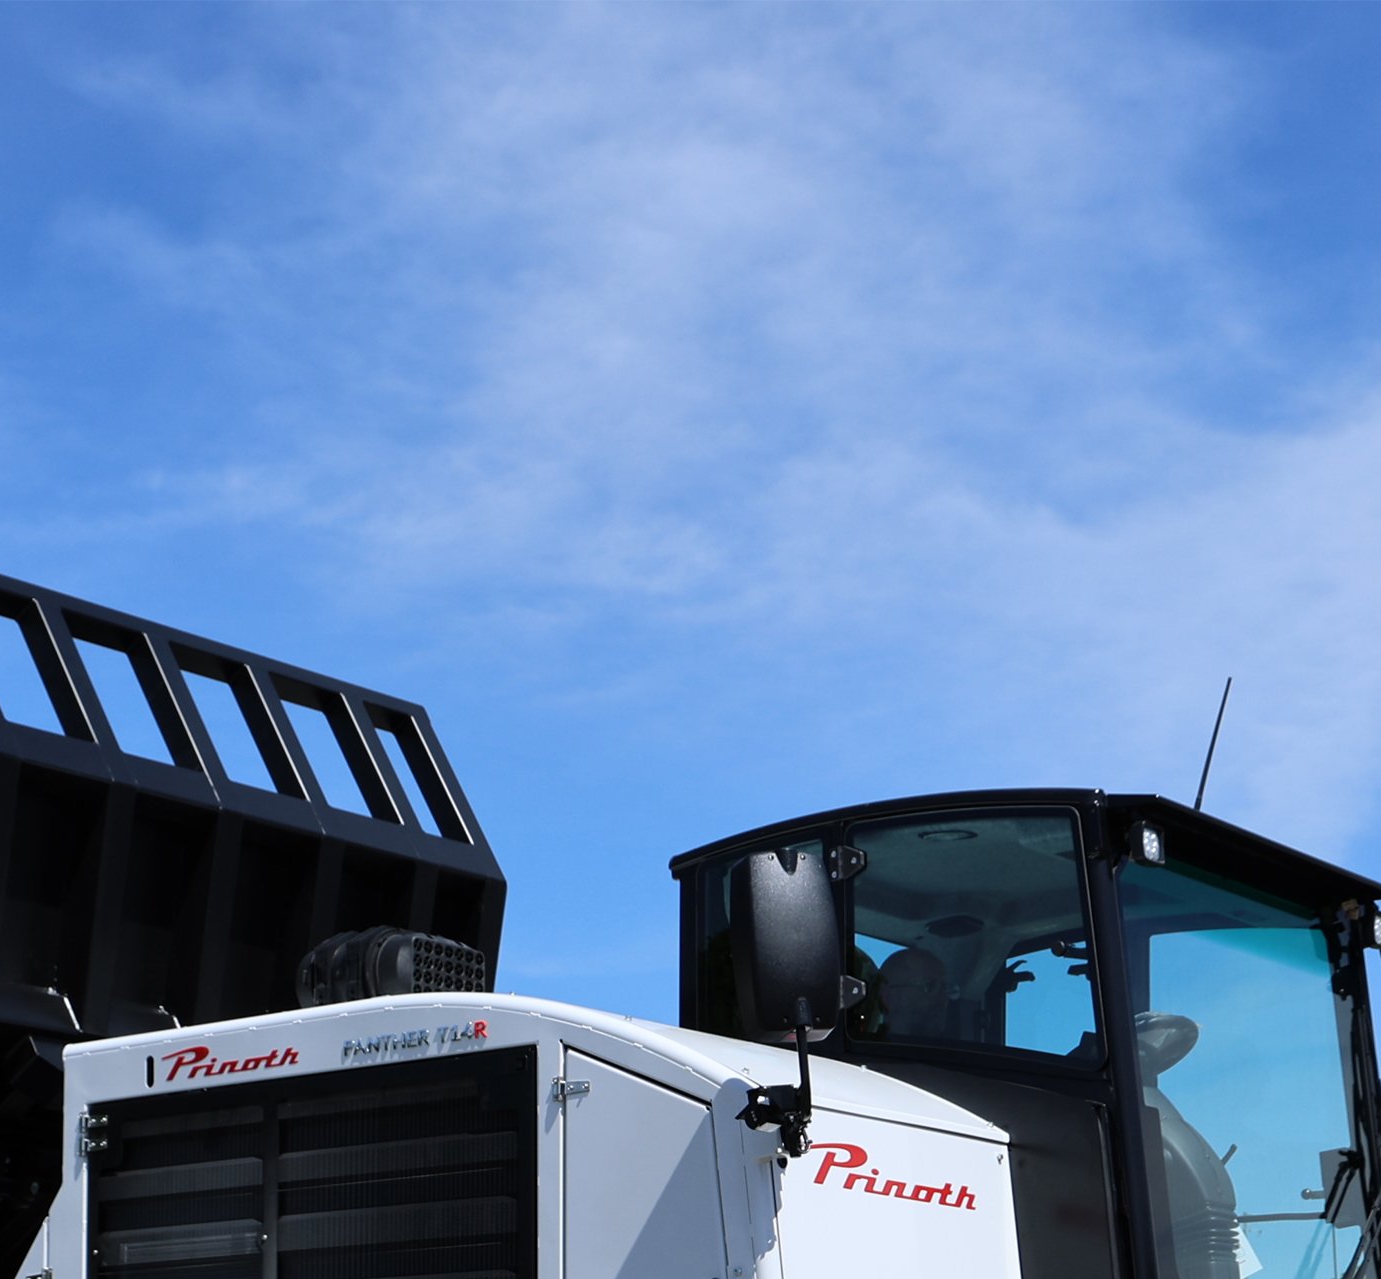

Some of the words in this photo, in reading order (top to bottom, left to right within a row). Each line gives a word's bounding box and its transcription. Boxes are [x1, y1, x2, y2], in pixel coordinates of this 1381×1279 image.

[343, 1030, 430, 1057] PANTHER
[437, 1020, 488, 1044] T14R
[161, 1046, 299, 1082] Prinoth
[810, 1143, 977, 1211] Prinoth
